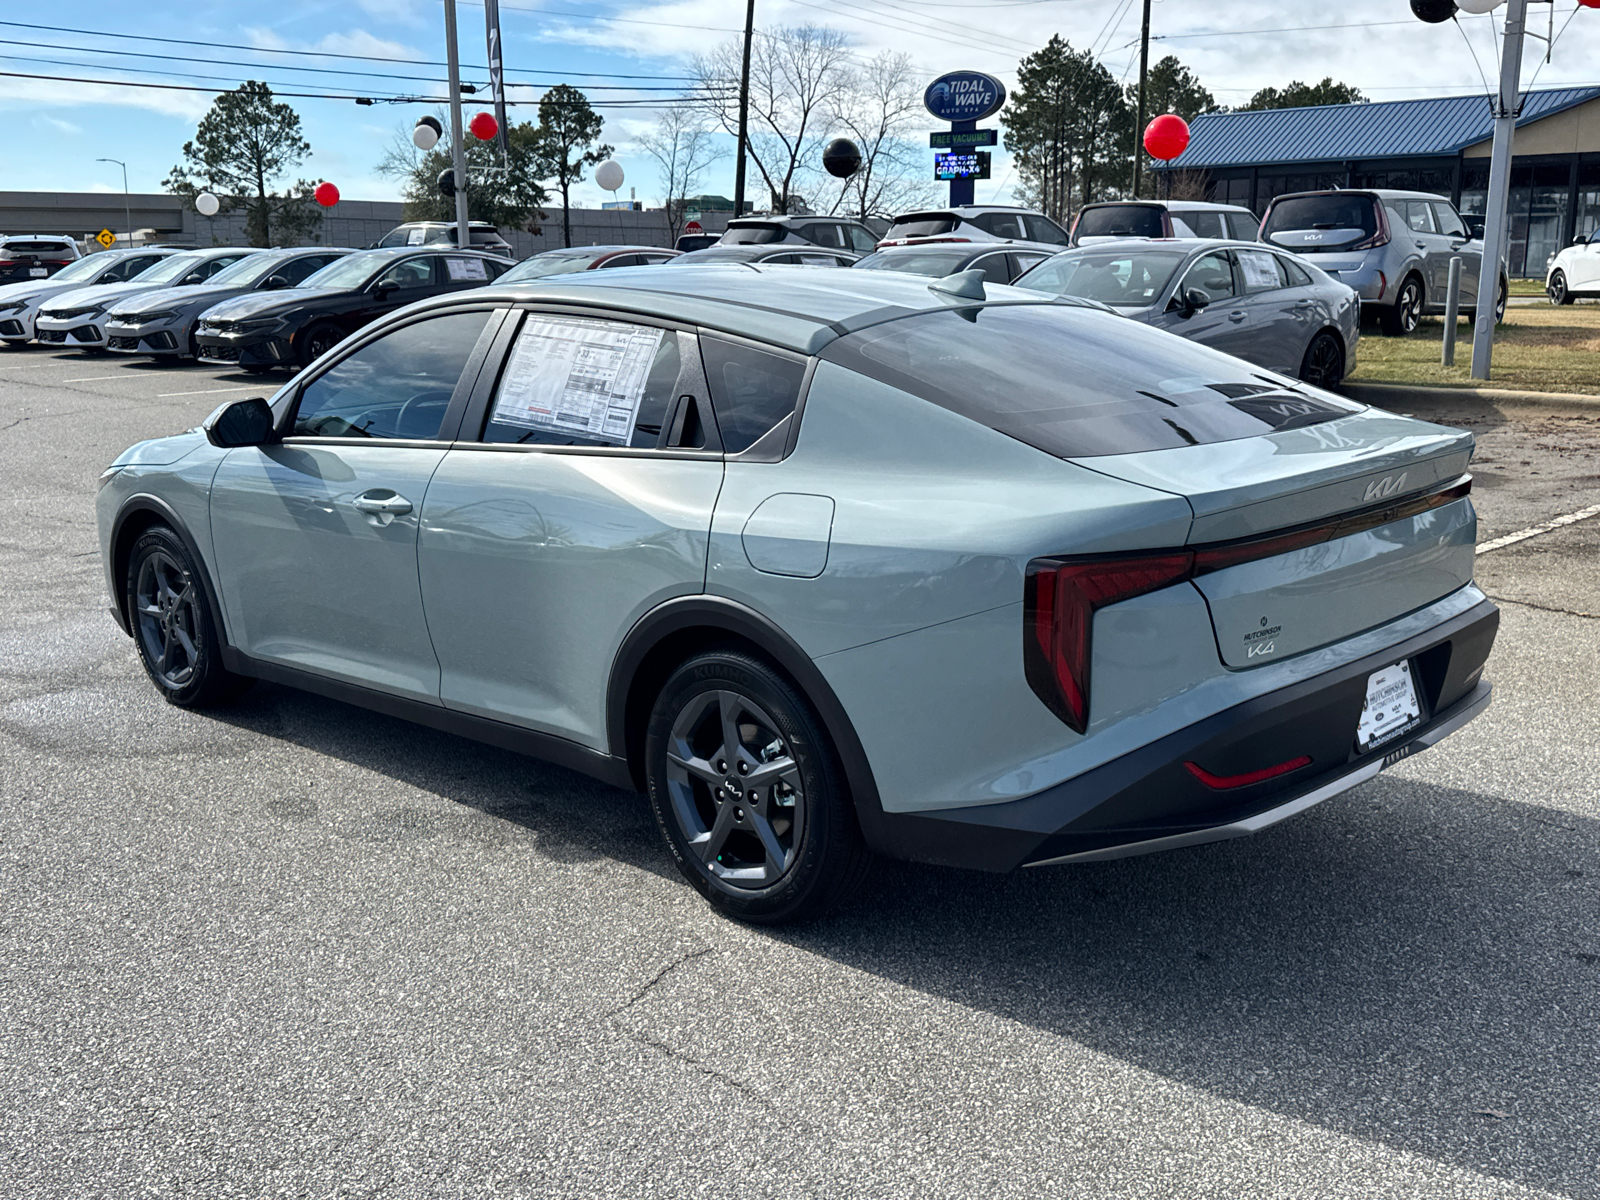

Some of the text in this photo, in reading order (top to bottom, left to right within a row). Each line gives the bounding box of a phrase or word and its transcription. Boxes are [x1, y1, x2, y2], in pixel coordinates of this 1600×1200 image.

[950, 79, 985, 93] TIDAL
[955, 92, 991, 105] WAVE
[932, 132, 988, 144] FREE VACUUMS
[581, 350, 590, 358] 33
[1362, 472, 1408, 502] KIA
[1243, 625, 1281, 641] HUTCHINSON
[1247, 640, 1275, 659] K4
[693, 665, 753, 686] KUMHO
[1368, 679, 1408, 705] HUTCHINSON
[1372, 689, 1408, 712] AUTOMOTIVE GROUP
